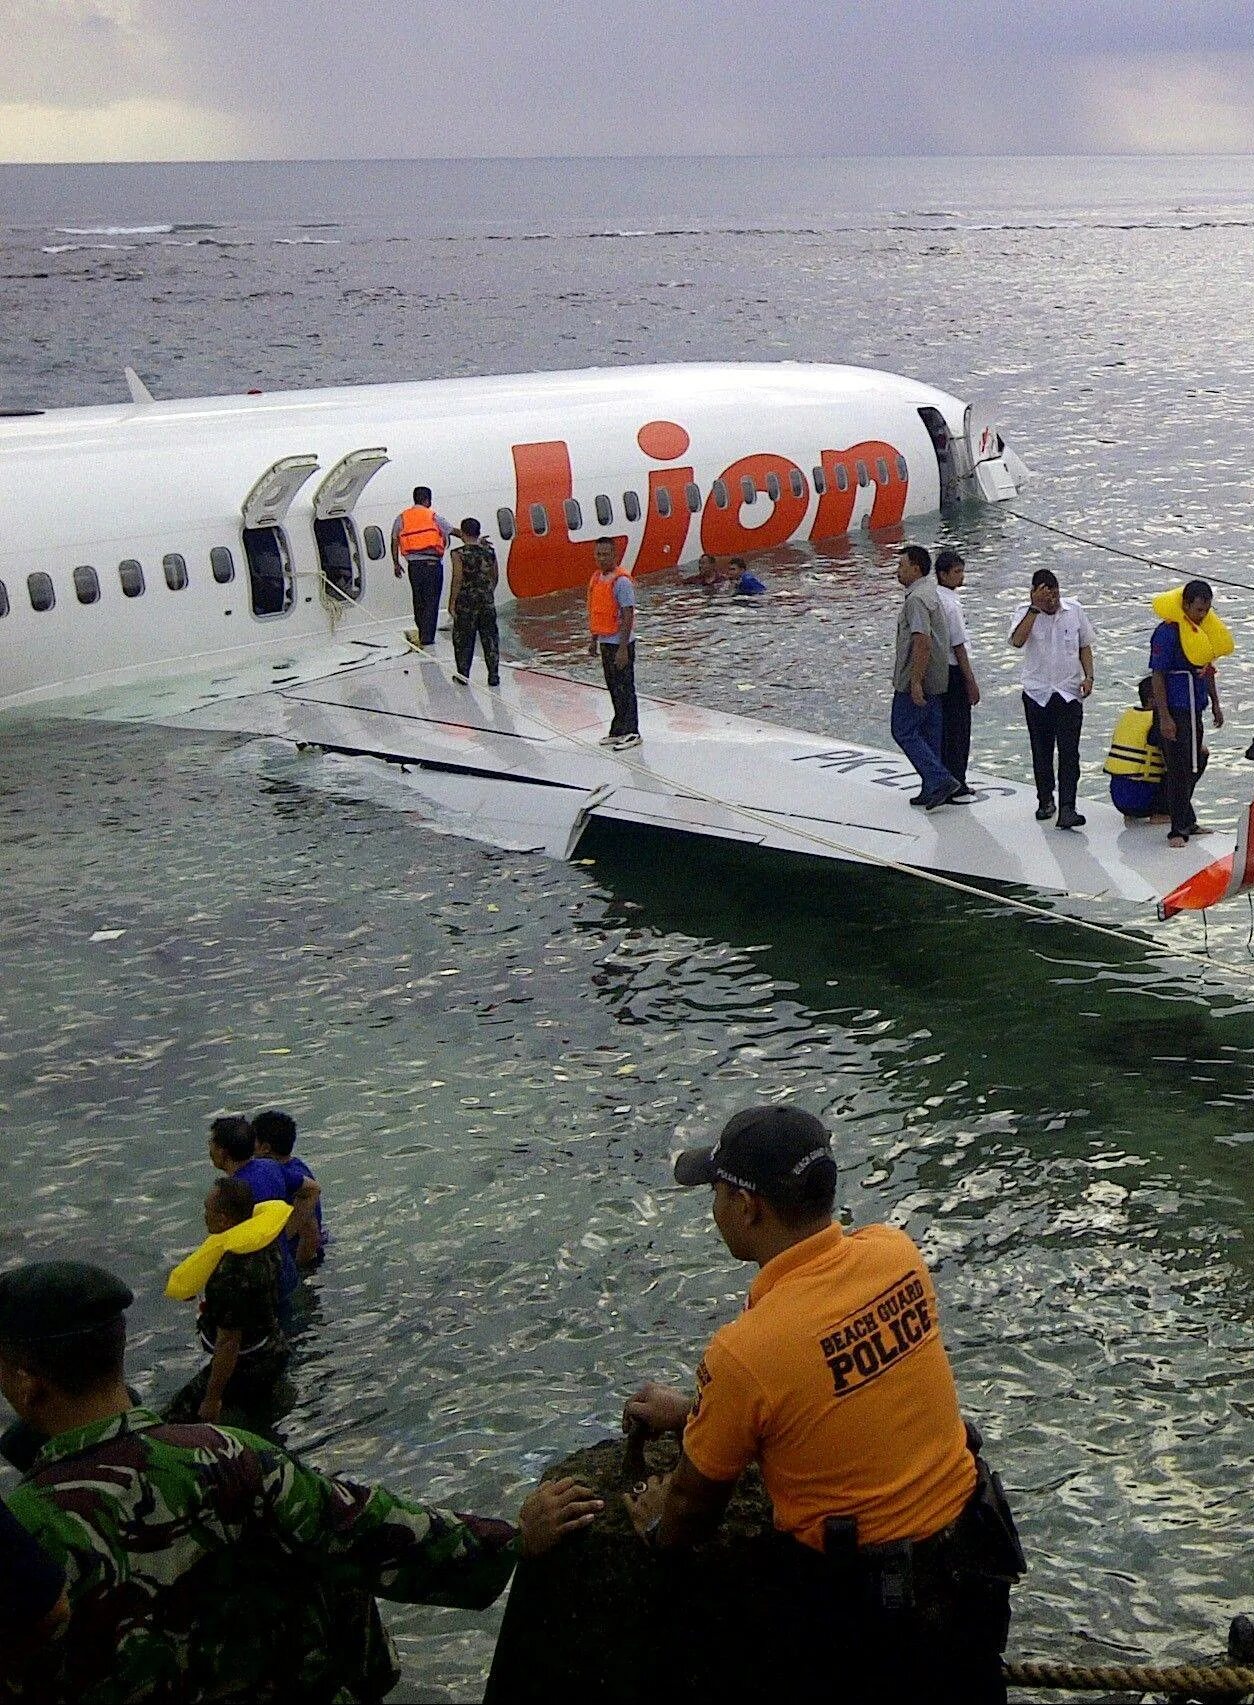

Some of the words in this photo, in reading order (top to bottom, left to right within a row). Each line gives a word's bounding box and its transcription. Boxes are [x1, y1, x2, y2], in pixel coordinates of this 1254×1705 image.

[507, 420, 908, 599] Lion
[791, 748, 1016, 805] PK-LS
[820, 1312, 879, 1358] BEACH
[877, 1279, 924, 1322] GUARD
[827, 1298, 932, 1391] POLICE
